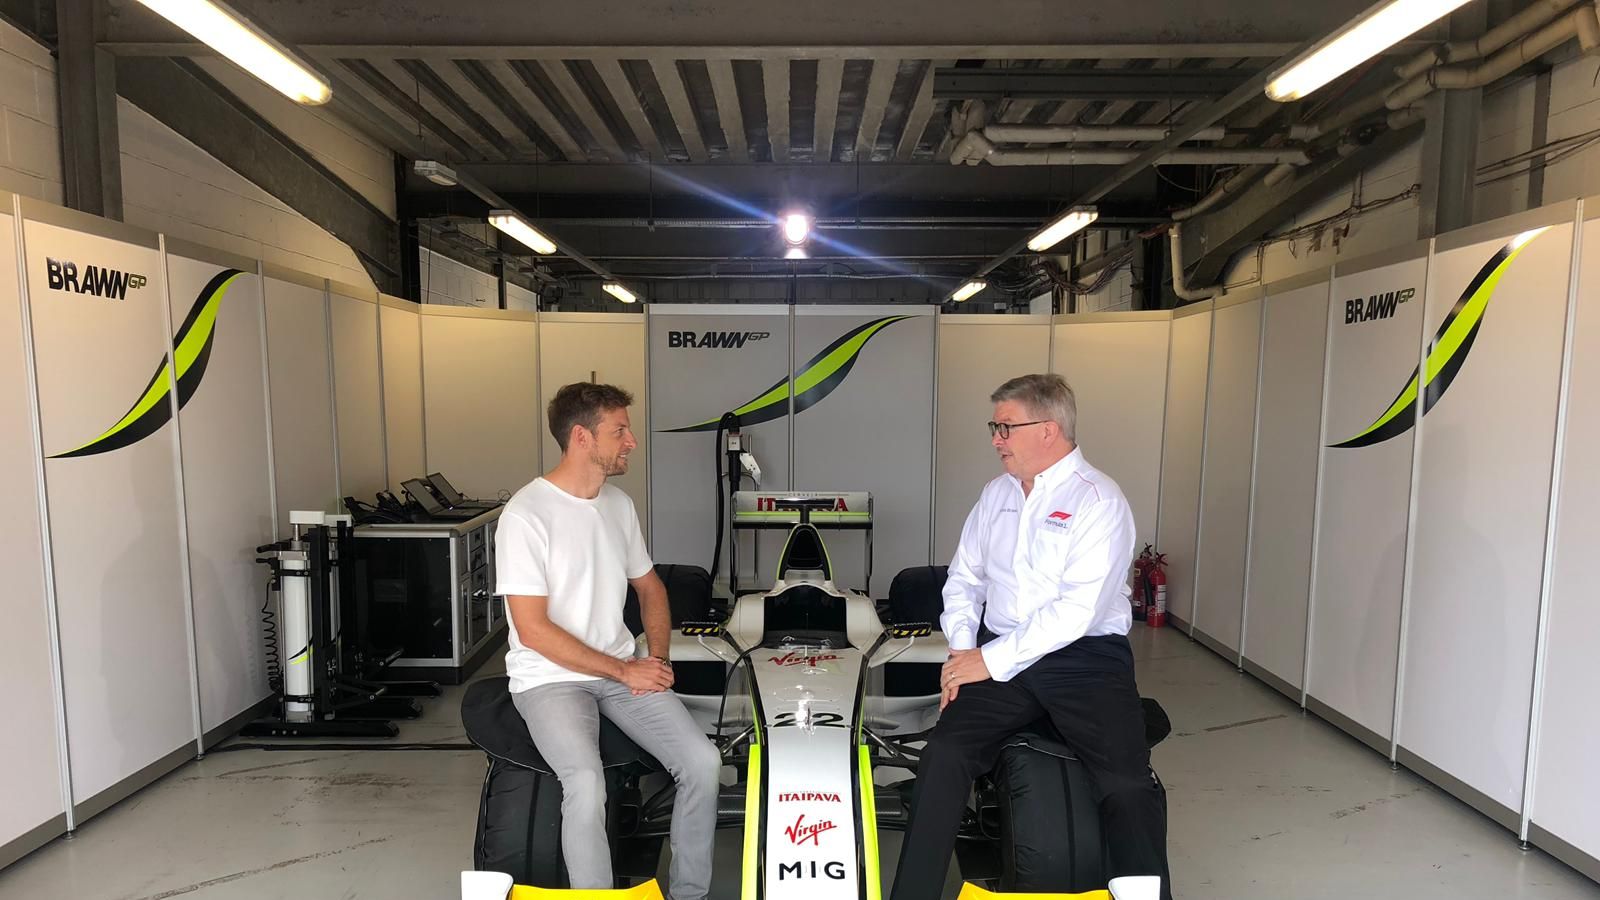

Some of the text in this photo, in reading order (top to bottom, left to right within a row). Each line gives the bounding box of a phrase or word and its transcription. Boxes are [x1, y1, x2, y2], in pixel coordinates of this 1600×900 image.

[46, 257, 129, 300] BRAWN
[1345, 290, 1400, 324] BRAWN
[668, 331, 749, 349] BRAWN
[773, 712, 845, 728] 22
[779, 793, 841, 803] ITAIPAVA
[784, 814, 837, 846] Virgin
[779, 861, 845, 881] MIG
